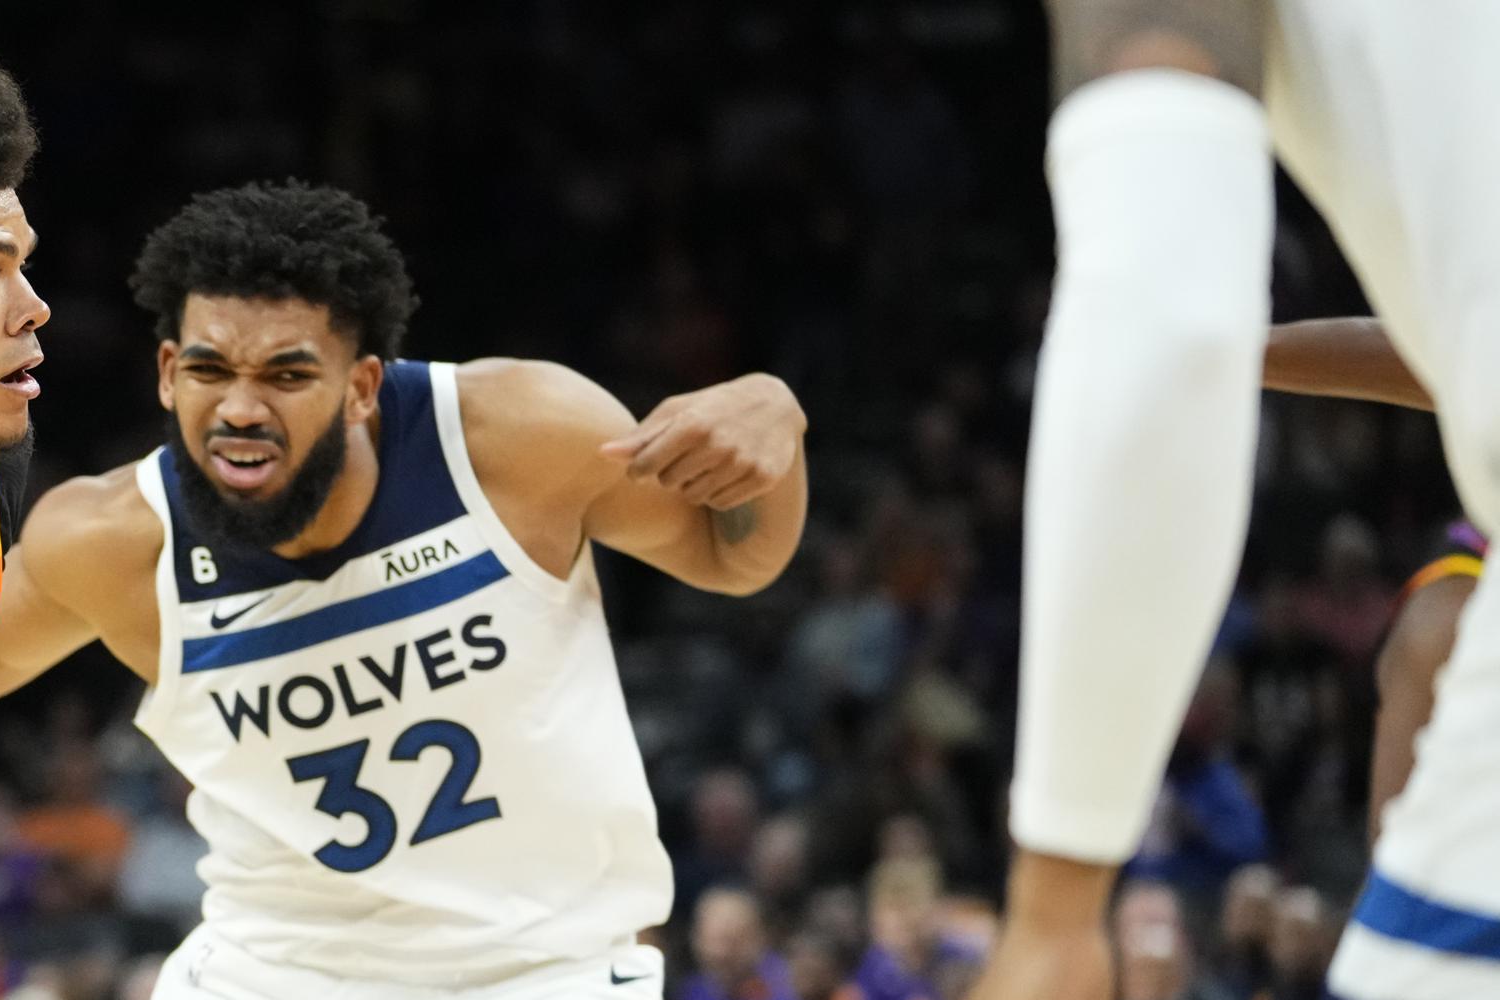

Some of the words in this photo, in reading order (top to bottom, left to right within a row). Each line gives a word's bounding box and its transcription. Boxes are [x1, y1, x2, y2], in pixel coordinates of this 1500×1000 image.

[190, 546, 218, 584] 6
[209, 614, 507, 743] WOLVES
[285, 718, 503, 873] 32
